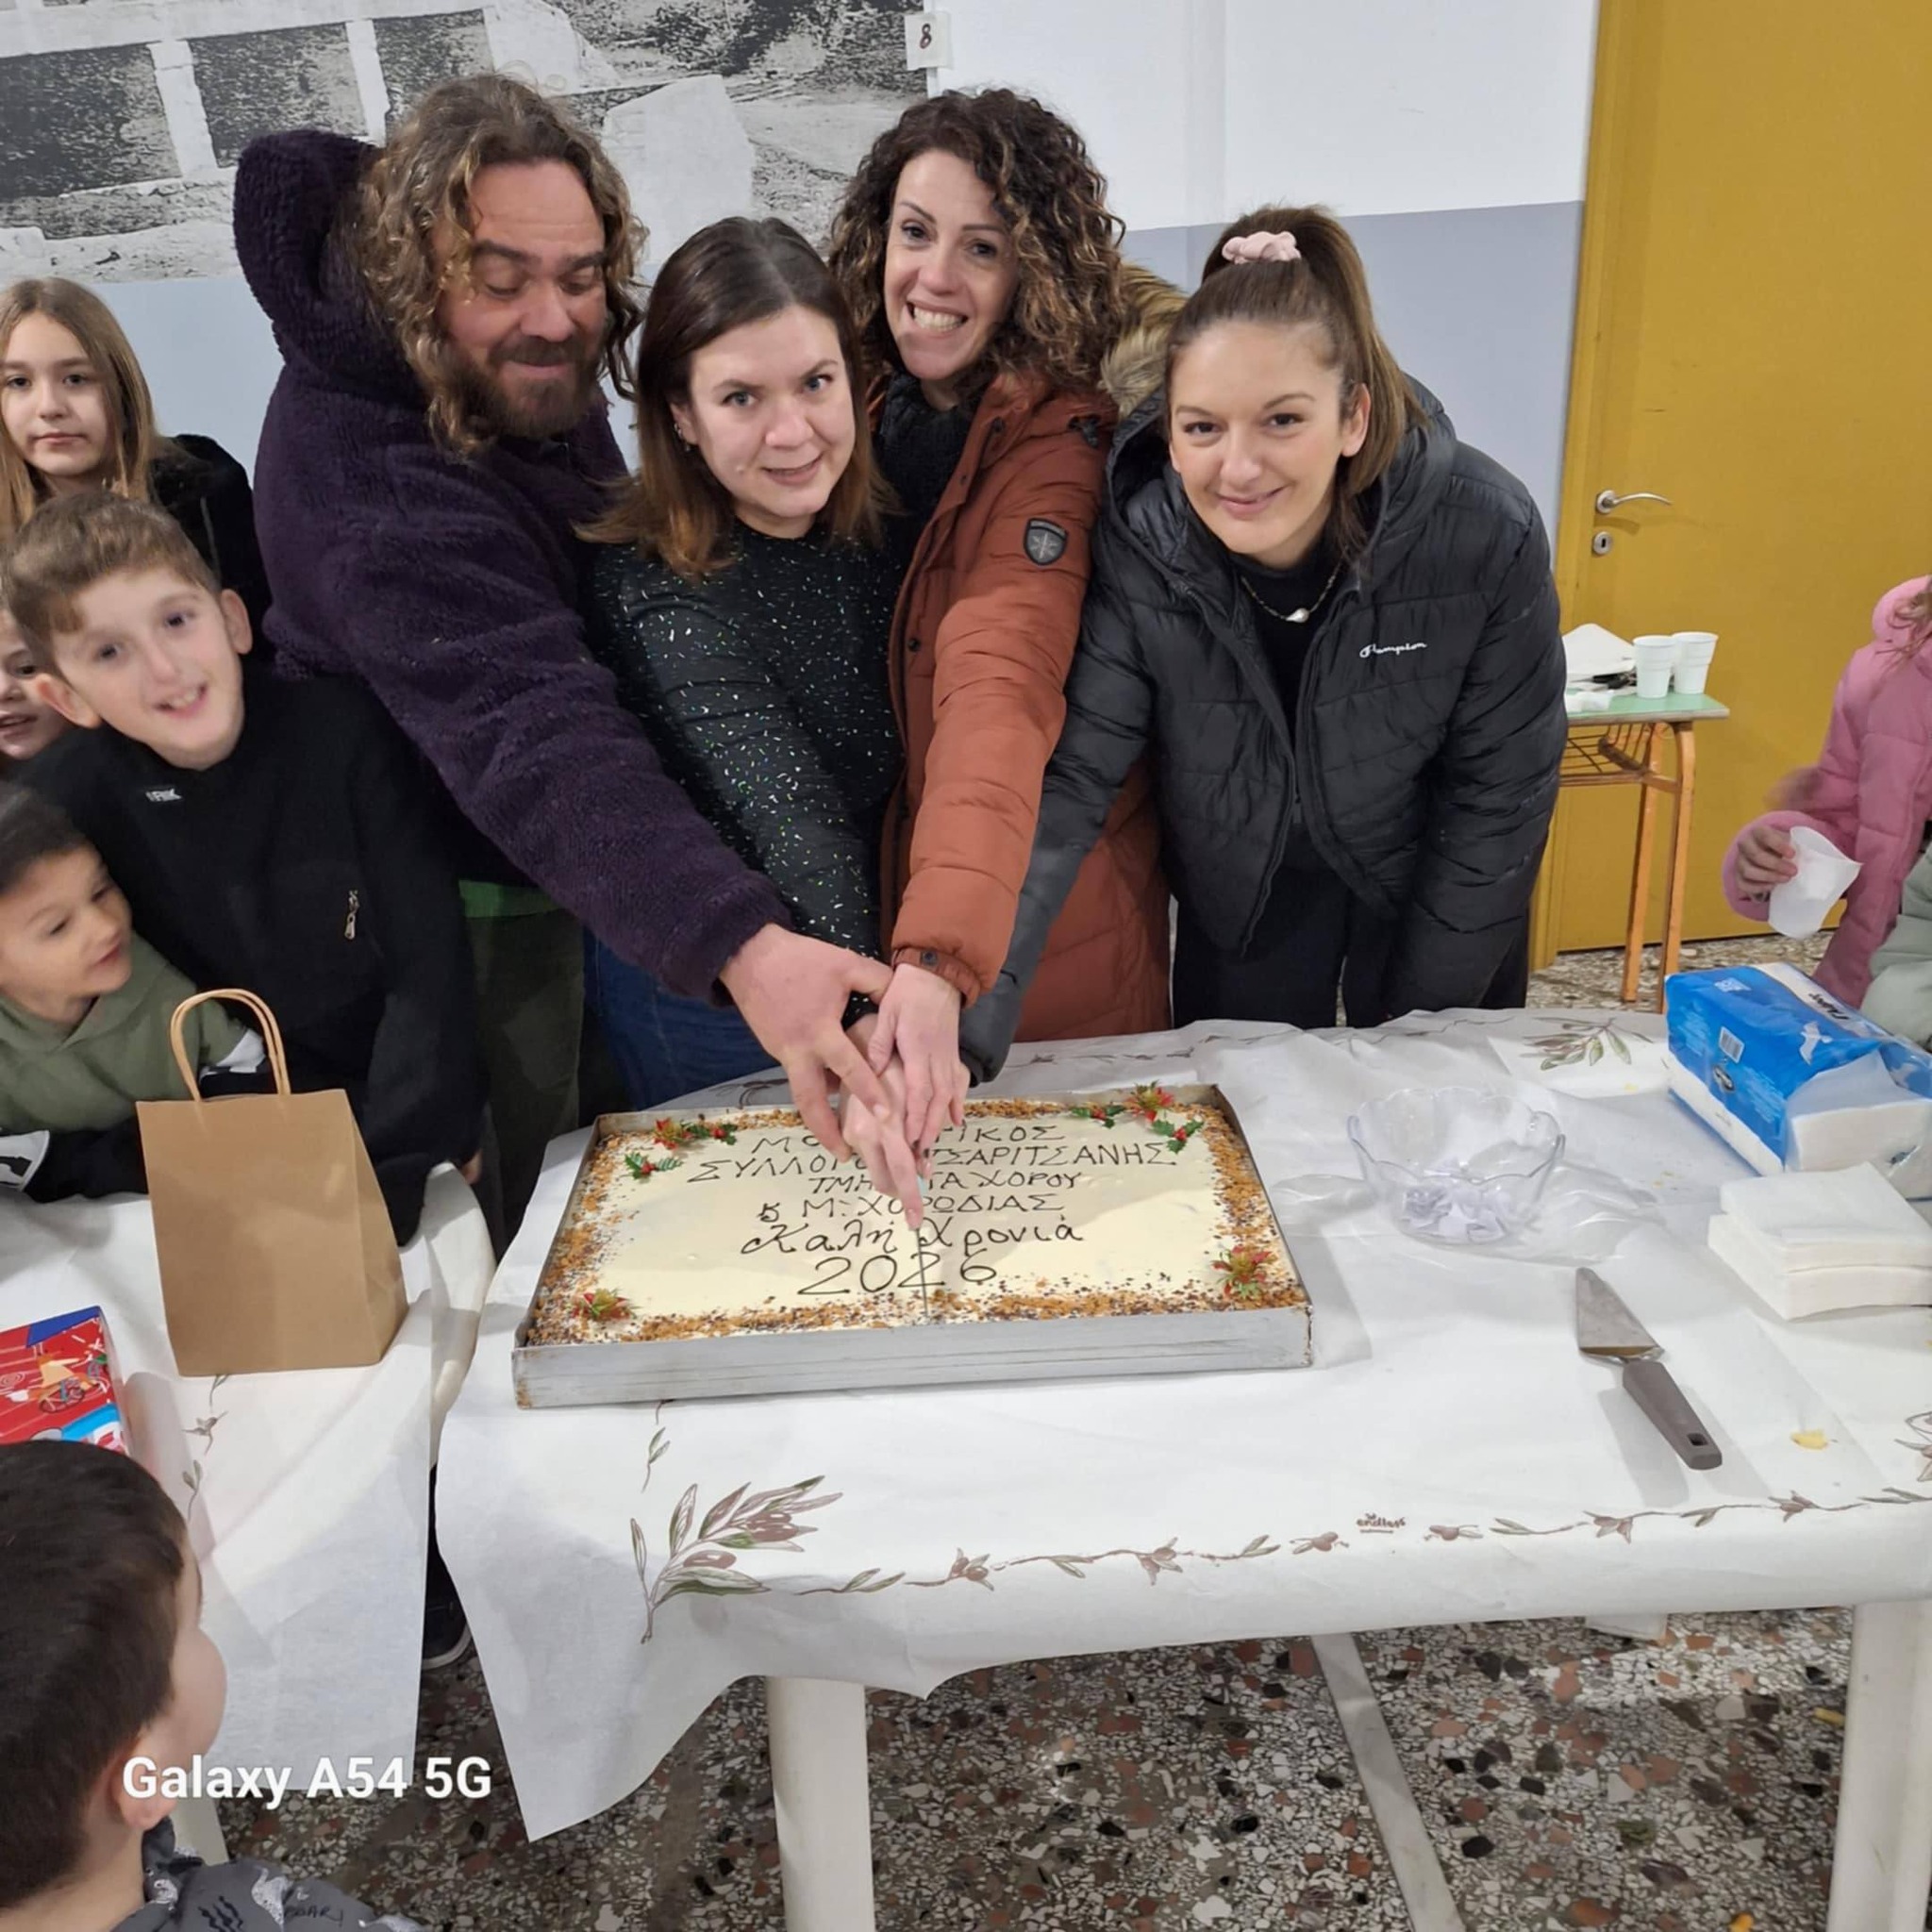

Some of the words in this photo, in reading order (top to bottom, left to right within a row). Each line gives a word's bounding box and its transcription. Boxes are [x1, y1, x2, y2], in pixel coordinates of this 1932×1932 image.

[919, 23, 933, 49] 8
[808, 1171, 969, 1194] ΤΜΗΤΑ
[969, 1169, 1082, 1190] ΧΟΡΟΥ
[740, 1219, 898, 1255] Καλή
[920, 1214, 1084, 1257] Χρονιά
[796, 1247, 997, 1295] 2026
